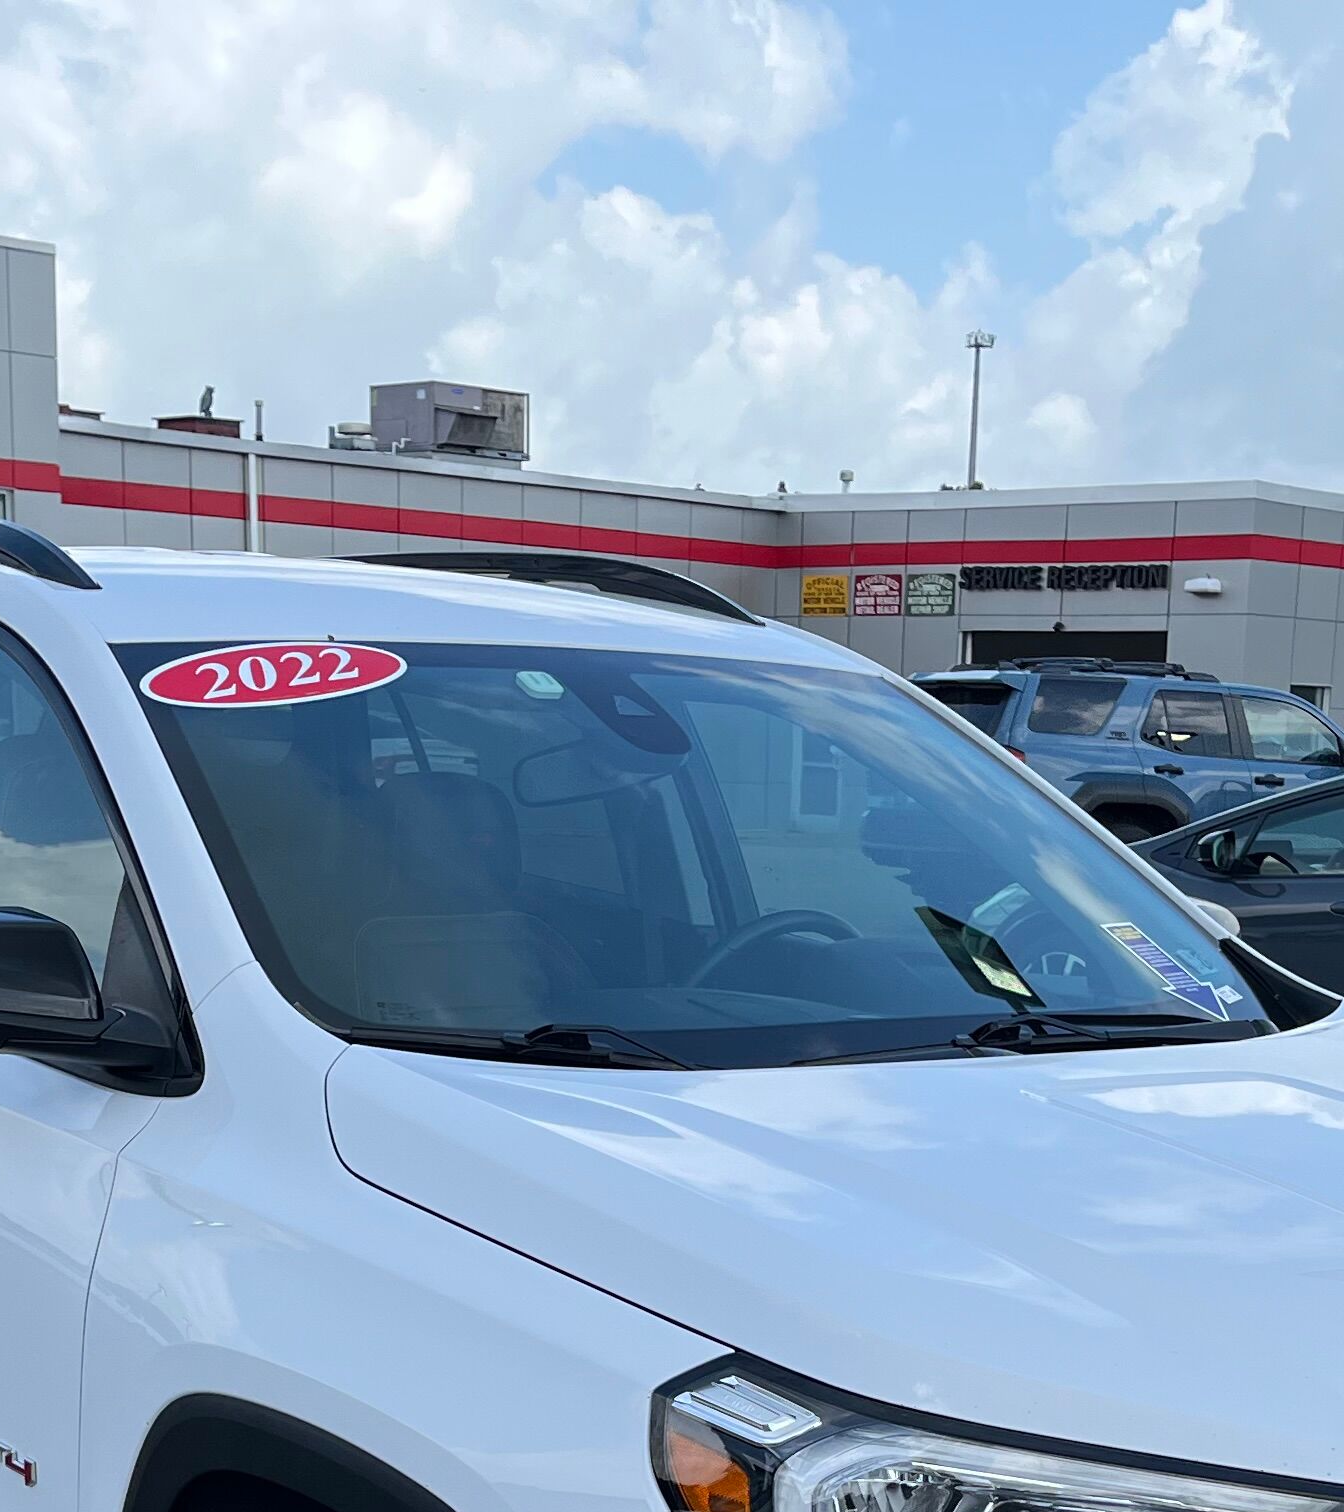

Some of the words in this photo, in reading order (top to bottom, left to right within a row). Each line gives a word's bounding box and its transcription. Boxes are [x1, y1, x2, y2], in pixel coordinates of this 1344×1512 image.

[959, 565, 1044, 591] SERVICE
[1047, 564, 1169, 590] RECEPTION
[195, 648, 359, 700] 2022
